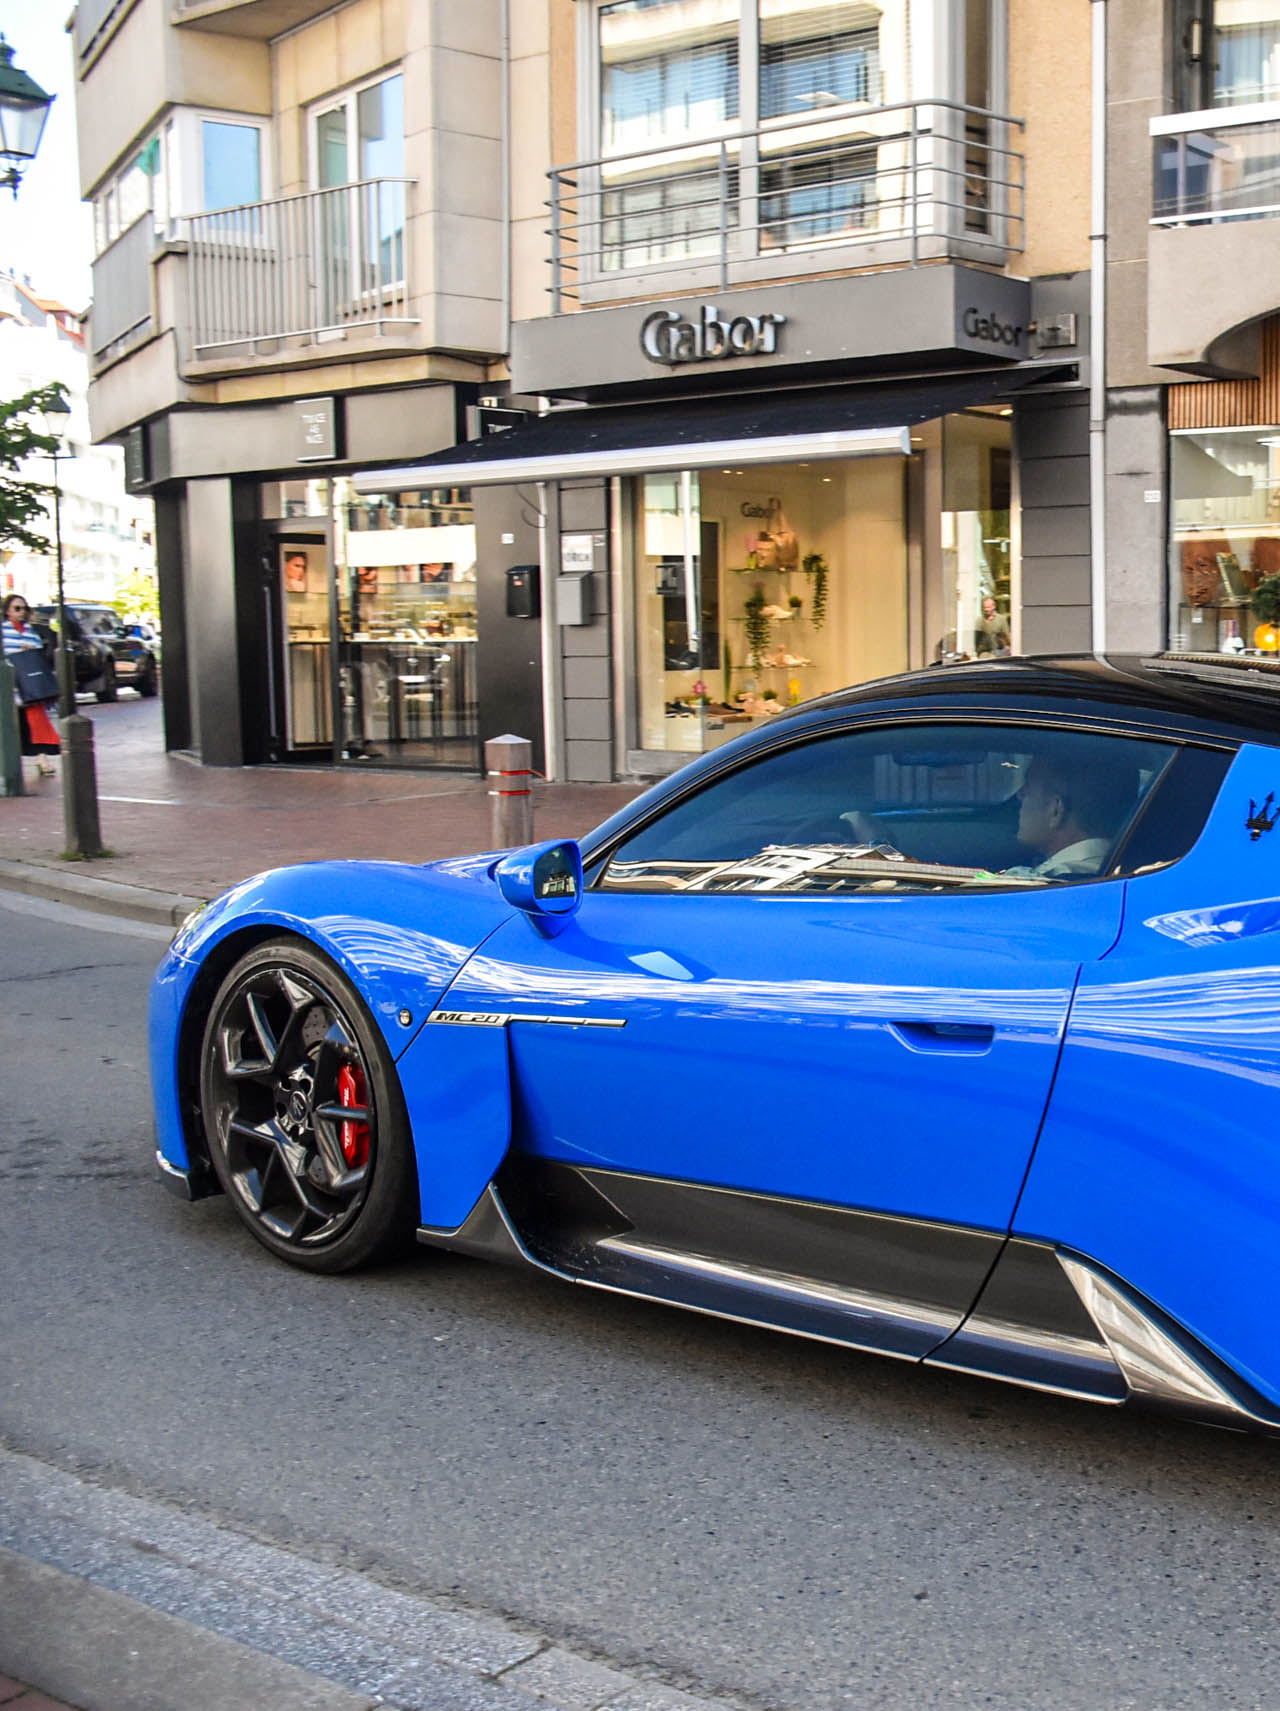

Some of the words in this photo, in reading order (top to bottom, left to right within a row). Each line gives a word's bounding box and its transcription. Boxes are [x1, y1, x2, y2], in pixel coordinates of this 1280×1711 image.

[640, 305, 788, 365] Gabor
[963, 307, 1023, 346] Gabor
[436, 1012, 501, 1024] MC20
